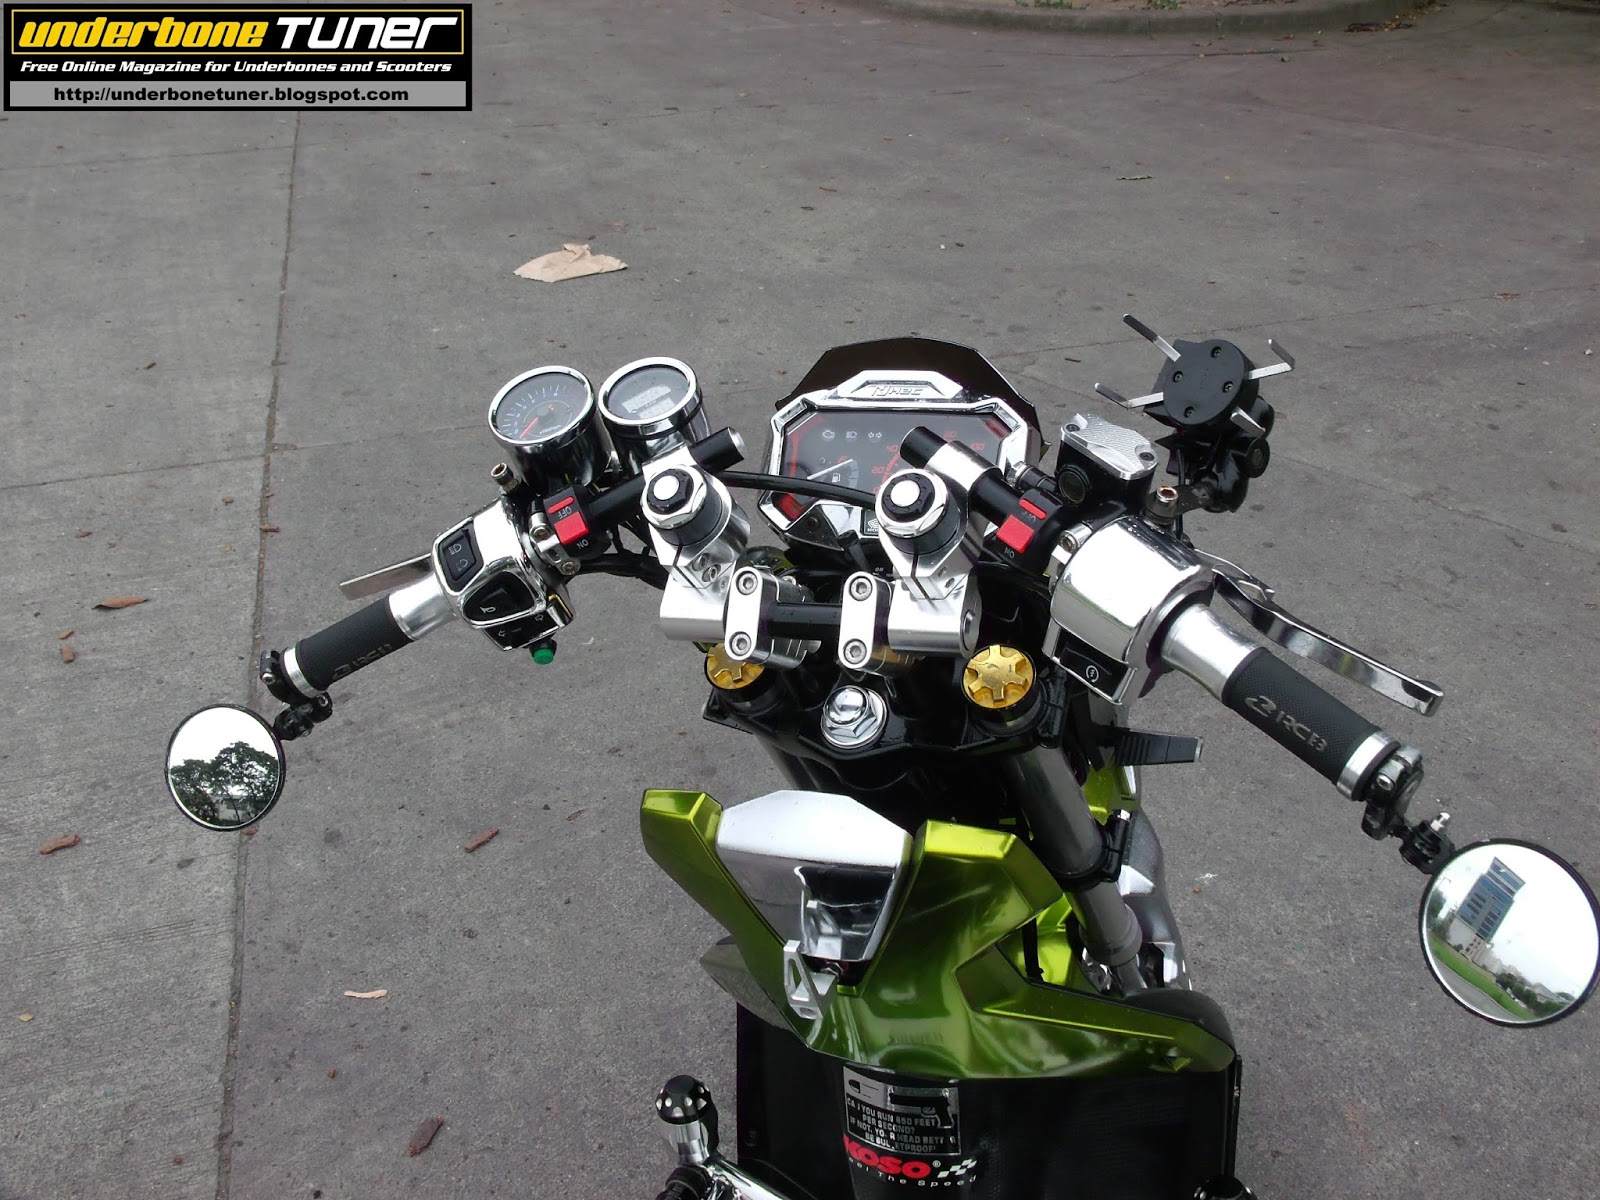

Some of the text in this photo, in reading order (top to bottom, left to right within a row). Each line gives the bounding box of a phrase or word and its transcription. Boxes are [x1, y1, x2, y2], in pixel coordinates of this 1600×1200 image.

[872, 466, 884, 474] 20
[558, 506, 573, 520] OFF
[576, 538, 589, 549] ON
[861, 1105, 876, 1118] YOU
[877, 1111, 894, 1123] RUN
[914, 1117, 936, 1127] FEET
[862, 1113, 916, 1134] PER SECOND?
[850, 1115, 857, 1125] IF
[874, 1127, 896, 1141] YOR
[896, 1133, 921, 1144] HEAD
[922, 1135, 956, 1145] BETTR
[864, 1132, 875, 1144] BE
[843, 1133, 931, 1179] KOSO
[877, 1170, 907, 1184] The
[917, 1174, 977, 1188] Speed
